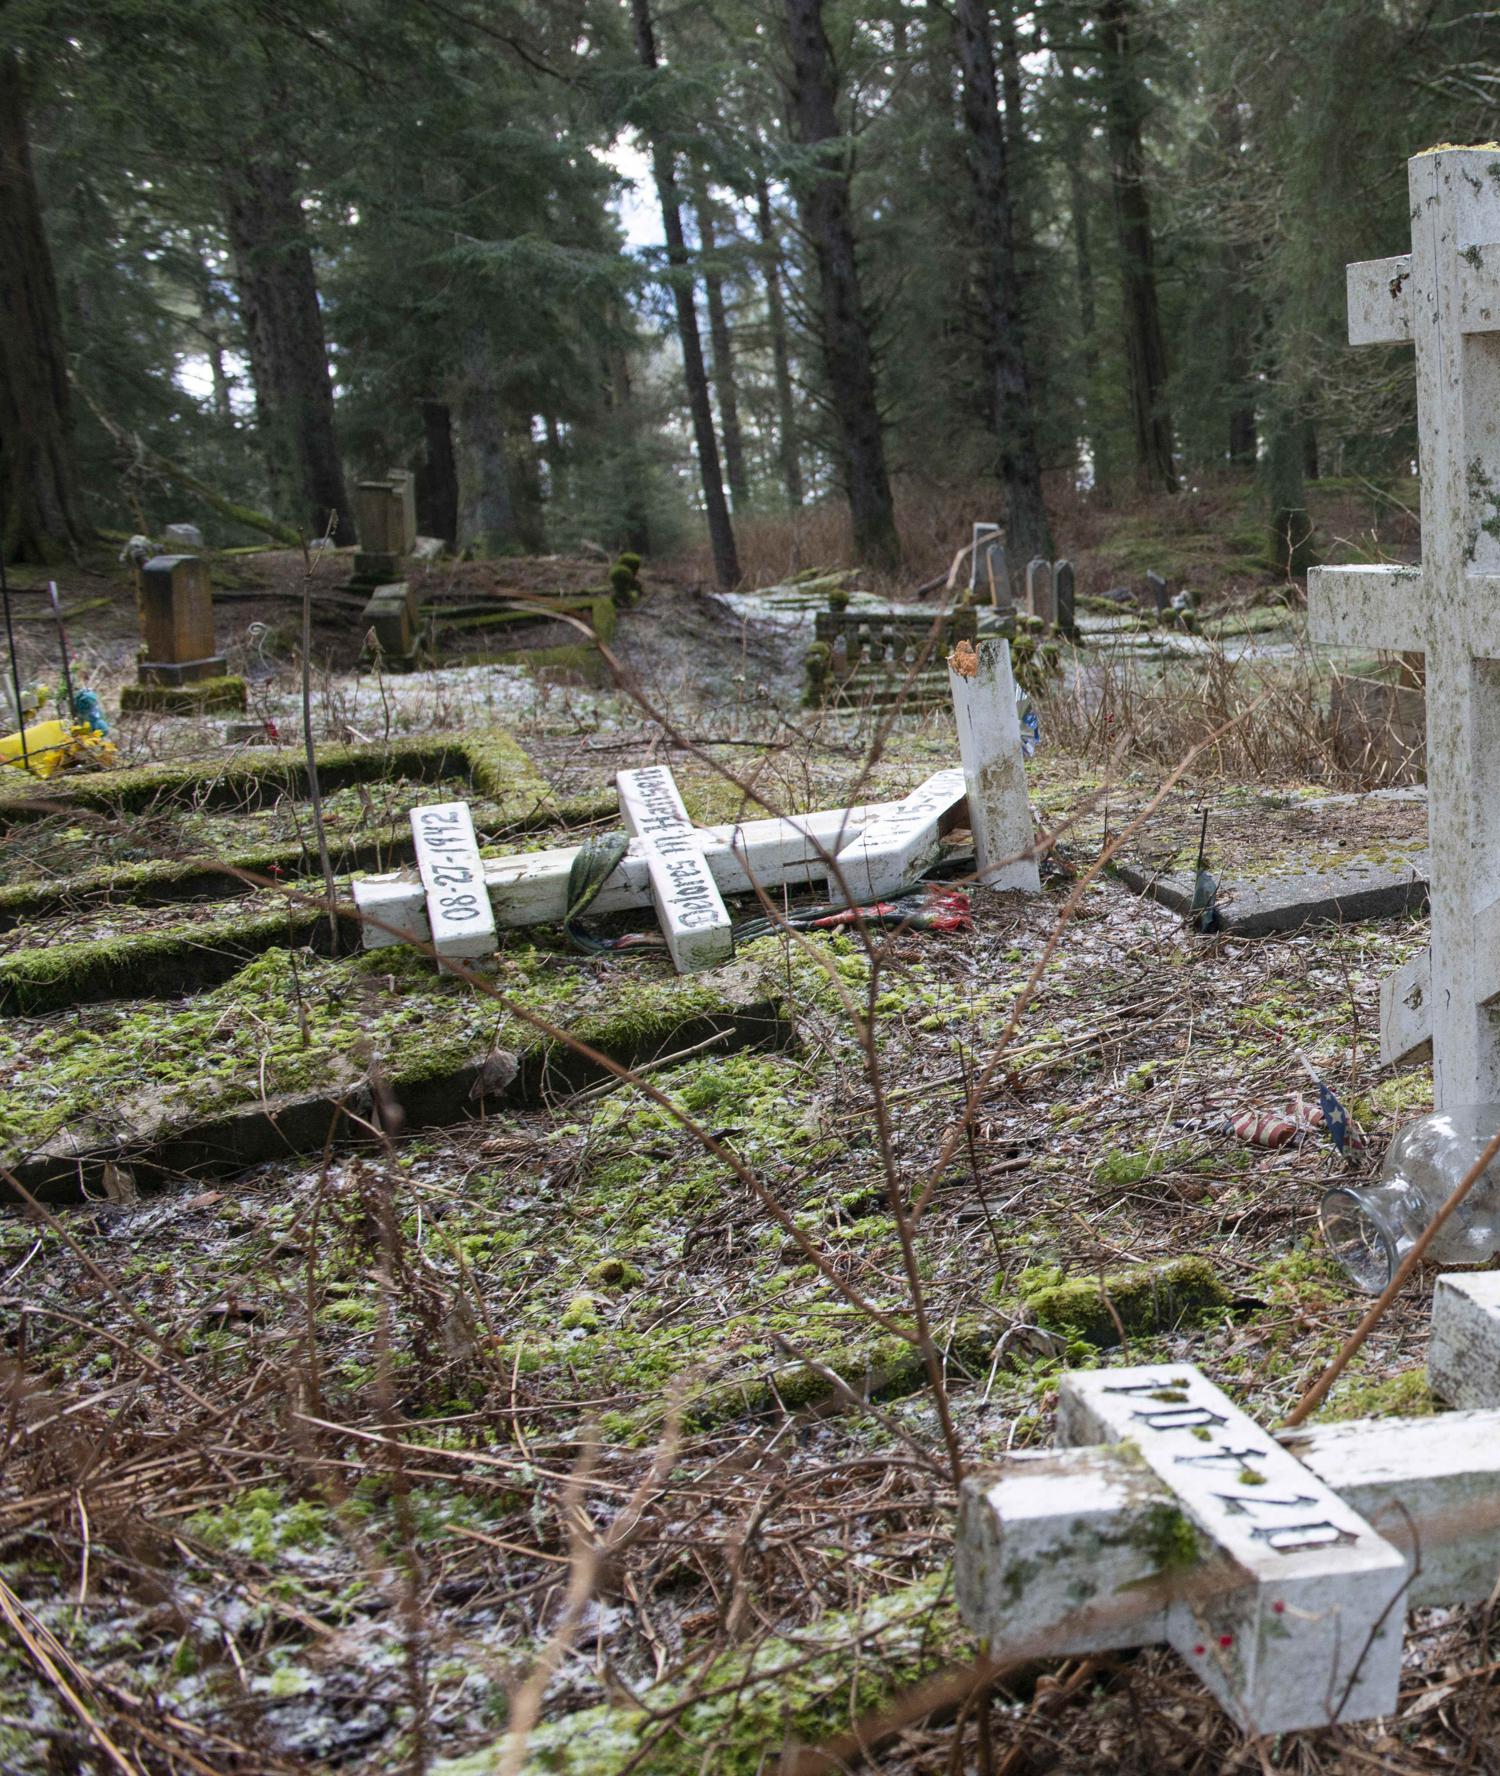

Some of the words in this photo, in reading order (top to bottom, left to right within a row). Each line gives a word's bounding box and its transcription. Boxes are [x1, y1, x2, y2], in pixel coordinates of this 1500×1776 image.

[420, 811, 481, 922] 08-27-1942
[666, 858, 719, 928] Delores
[1103, 1376, 1361, 1556] 07404
